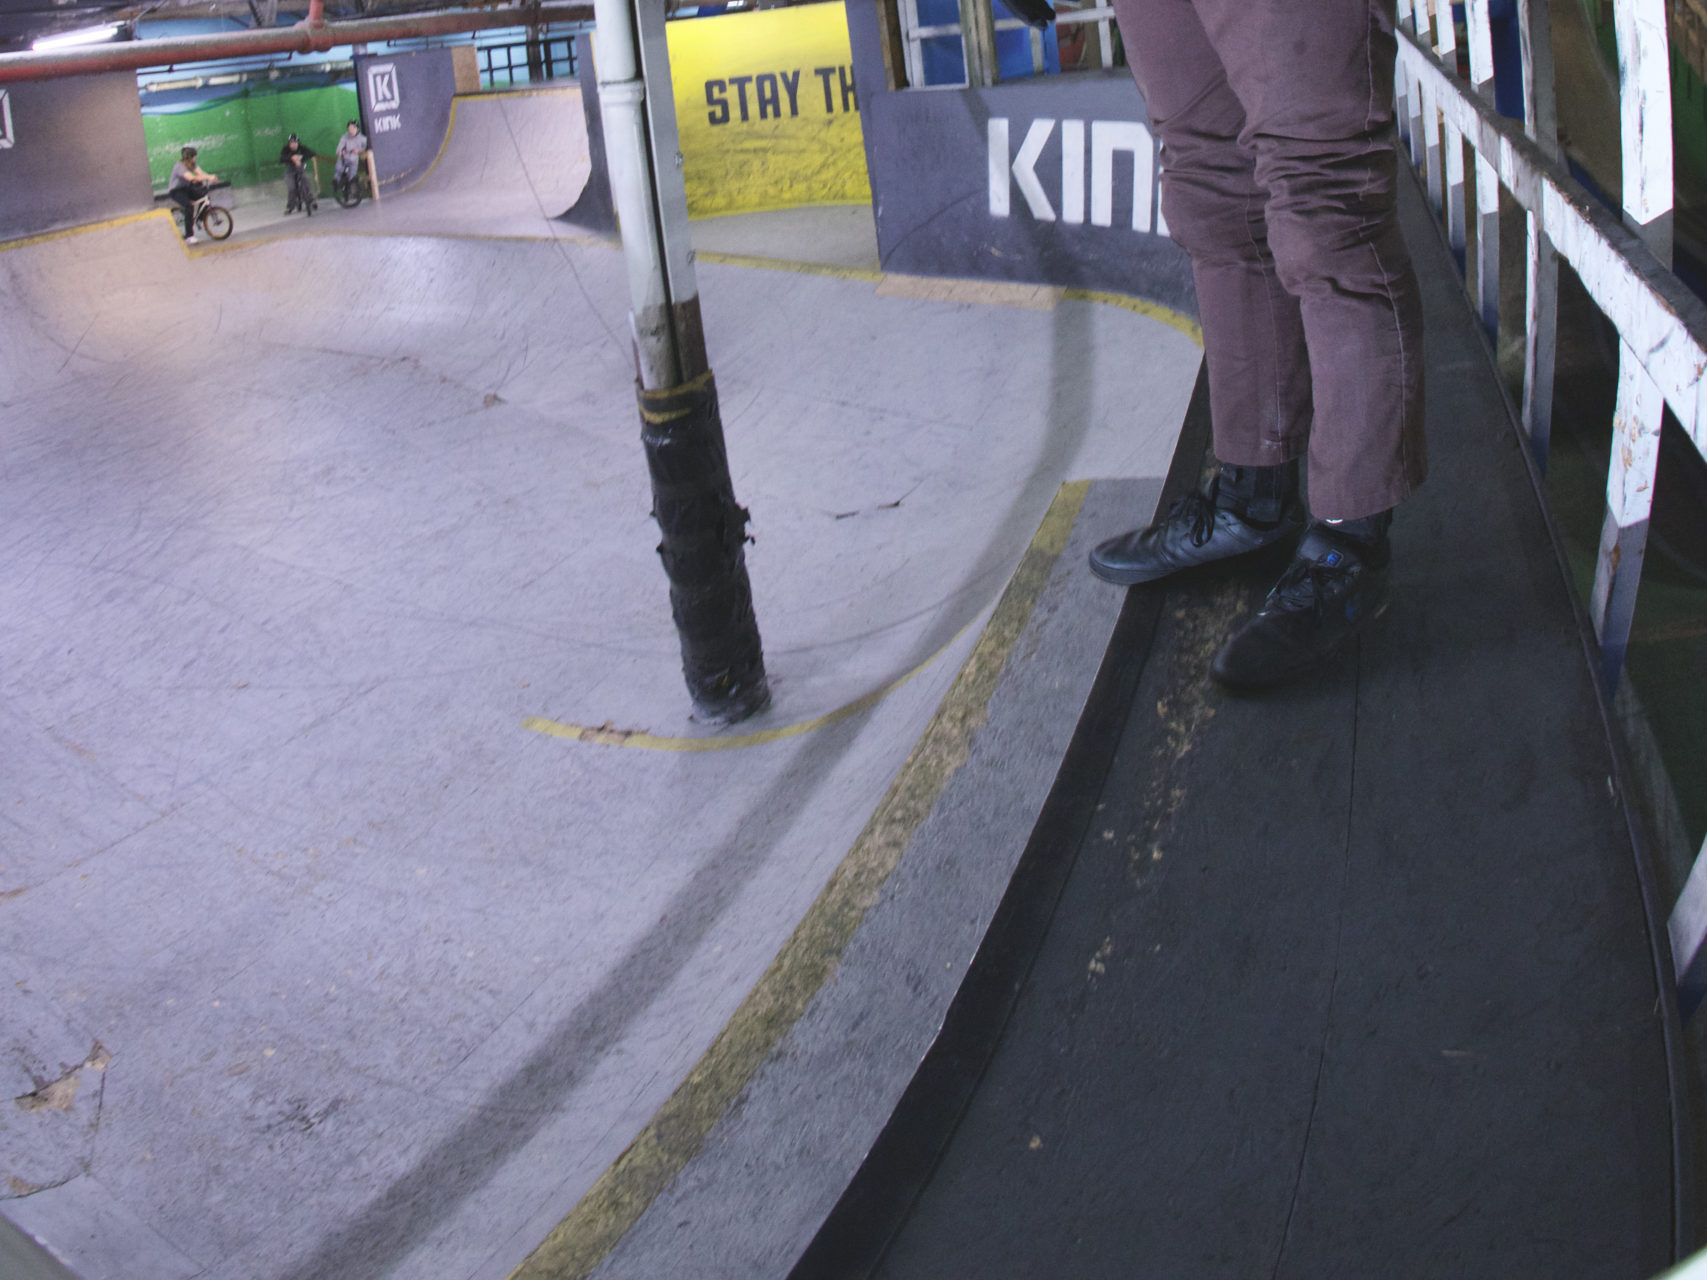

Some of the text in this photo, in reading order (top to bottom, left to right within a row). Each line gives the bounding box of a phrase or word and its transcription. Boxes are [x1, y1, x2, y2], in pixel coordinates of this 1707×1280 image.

[376, 73, 392, 101] K
[704, 69, 800, 126] STAY
[374, 113, 401, 134] KINK
[987, 117, 1170, 237] KIN
